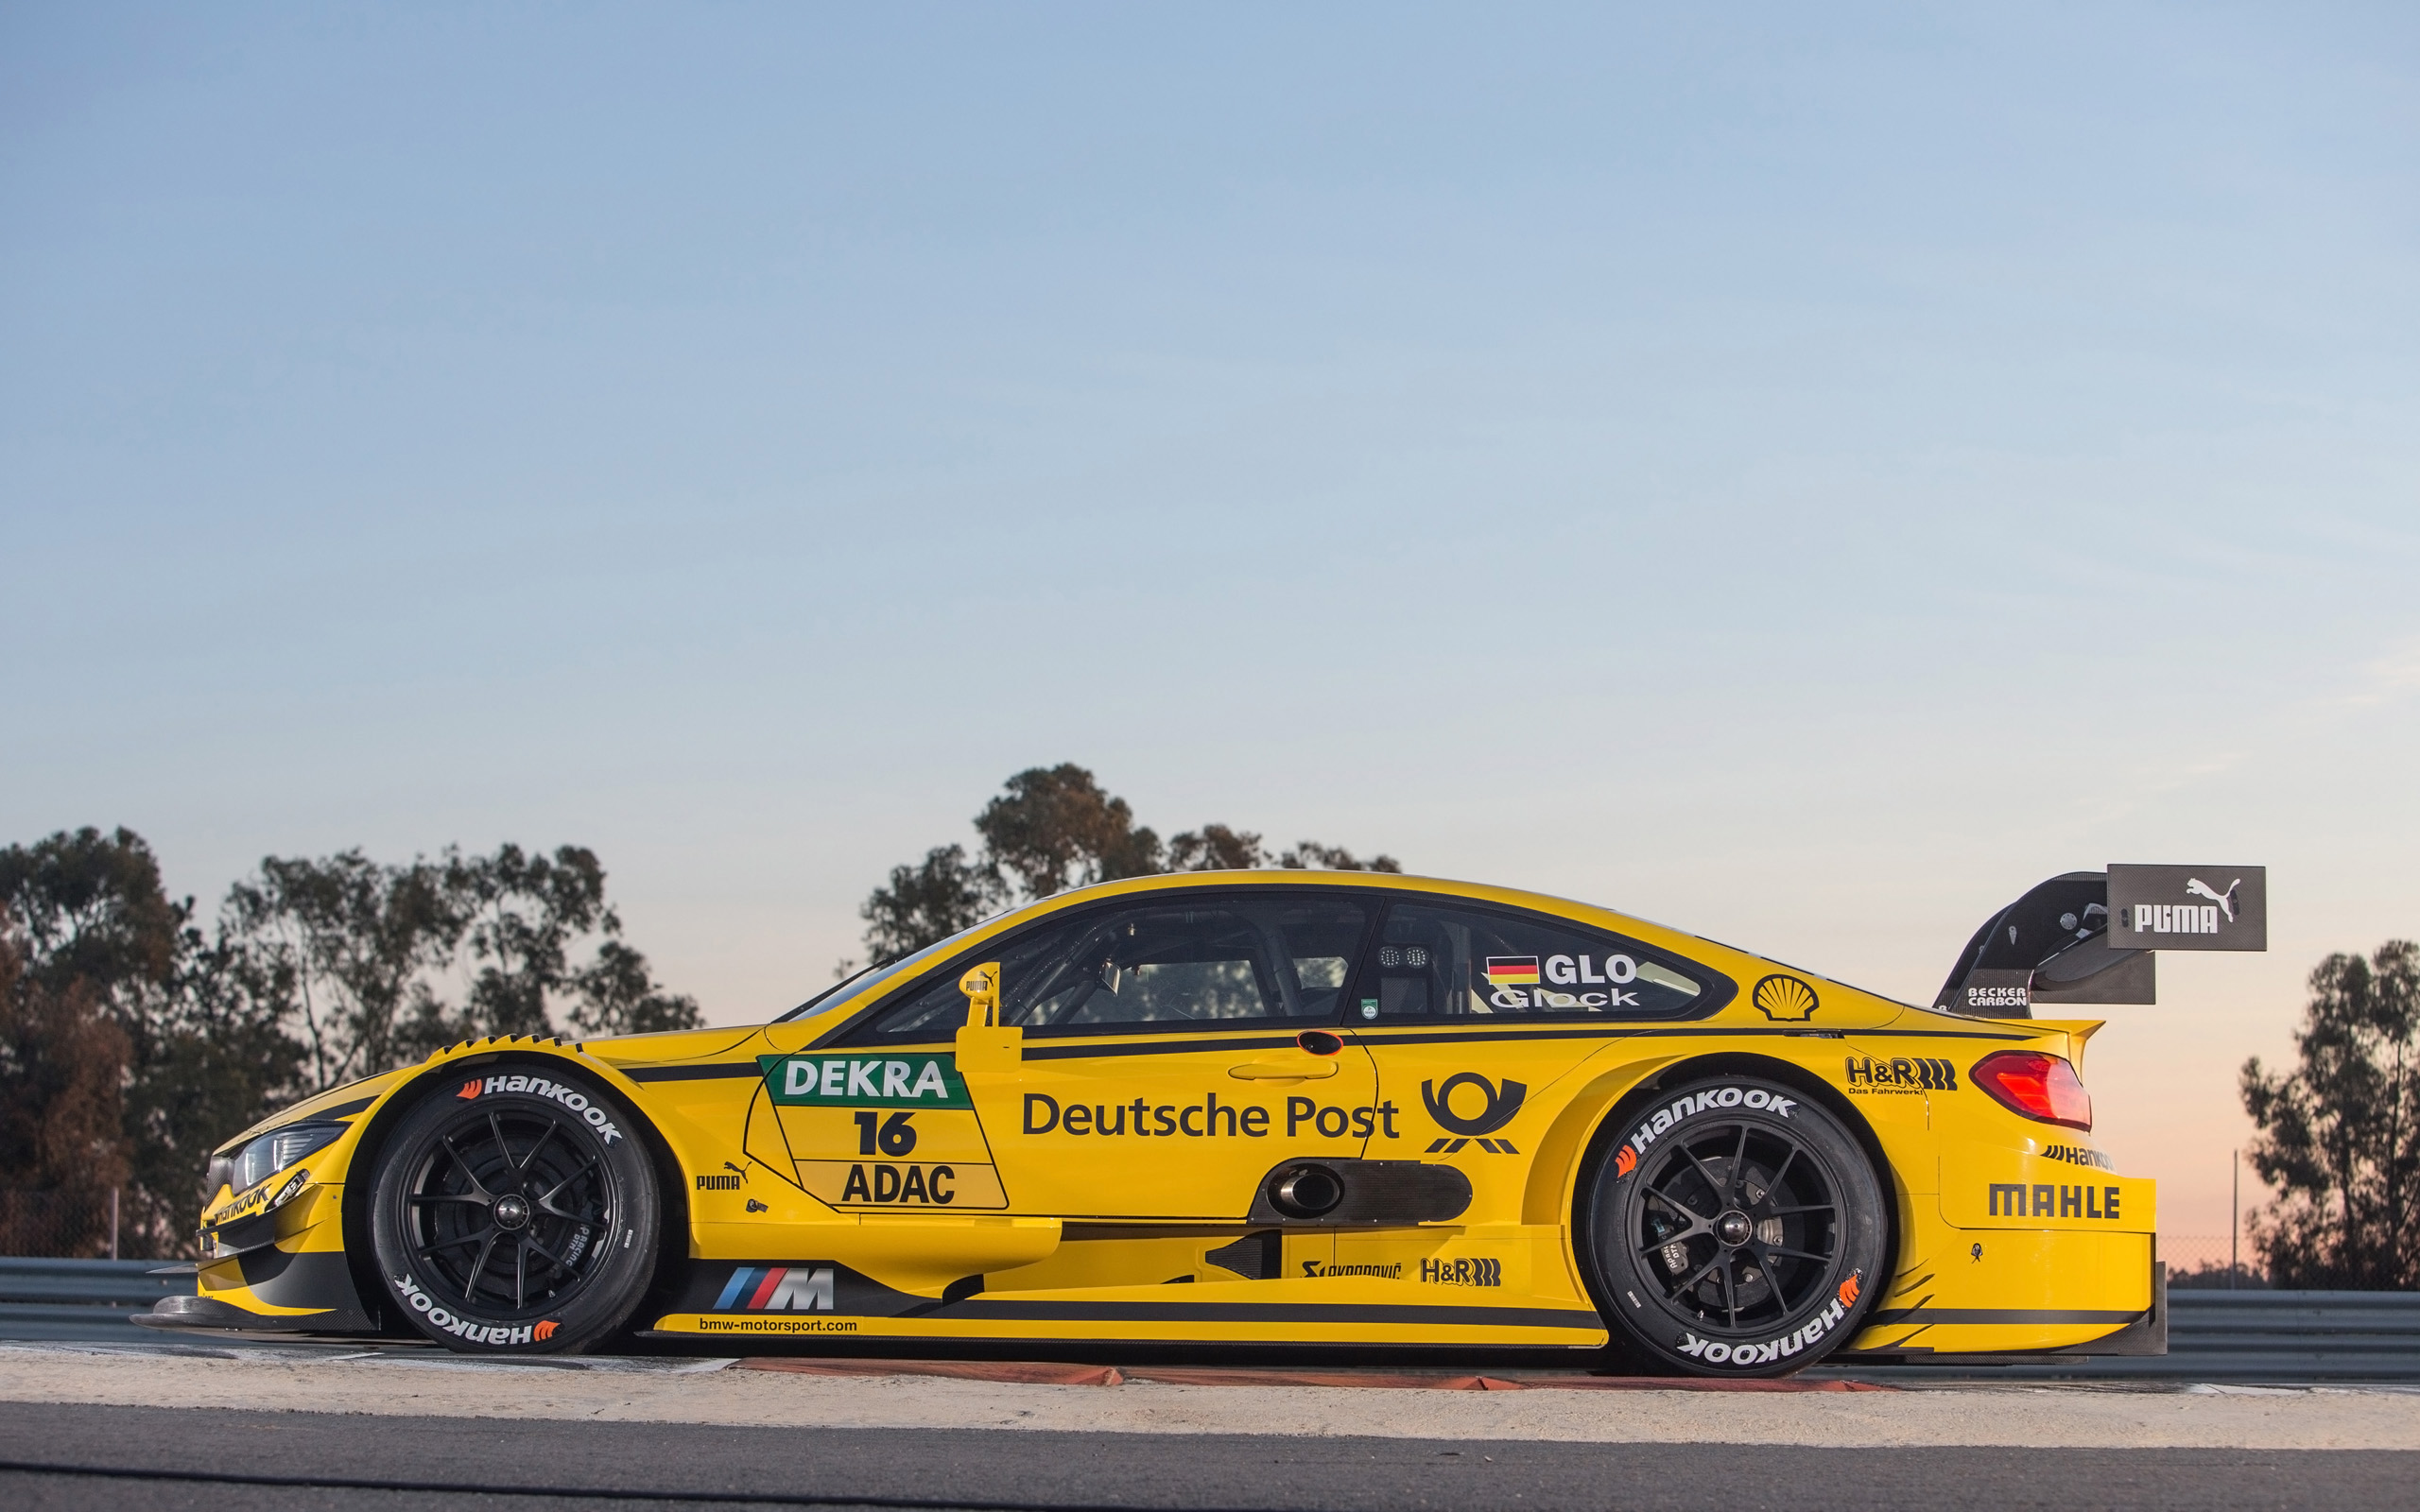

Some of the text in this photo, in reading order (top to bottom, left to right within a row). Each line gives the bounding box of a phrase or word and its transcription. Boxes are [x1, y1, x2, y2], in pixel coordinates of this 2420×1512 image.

[2135, 904, 2218, 934] PUMA
[1545, 954, 1637, 985] GLO
[966, 981, 988, 991] PUMA
[1491, 987, 1640, 1008] Glock
[1968, 988, 2027, 997] BECKER
[1968, 997, 2027, 1006] CARBON
[785, 1060, 948, 1098] DEKRA
[1845, 1057, 1921, 1090] H&R
[1023, 1092, 1400, 1140] Deutsche Post
[854, 1111, 917, 1158] 16
[697, 1176, 740, 1190] PUMA
[841, 1164, 956, 1204] ADAC
[1989, 1183, 2120, 1220] MAHLE
[569, 1233, 580, 1249] DTM
[1421, 1258, 1475, 1287] H&R
[764, 1267, 834, 1311] M
[699, 1317, 858, 1334] bmw-motorsport.com
